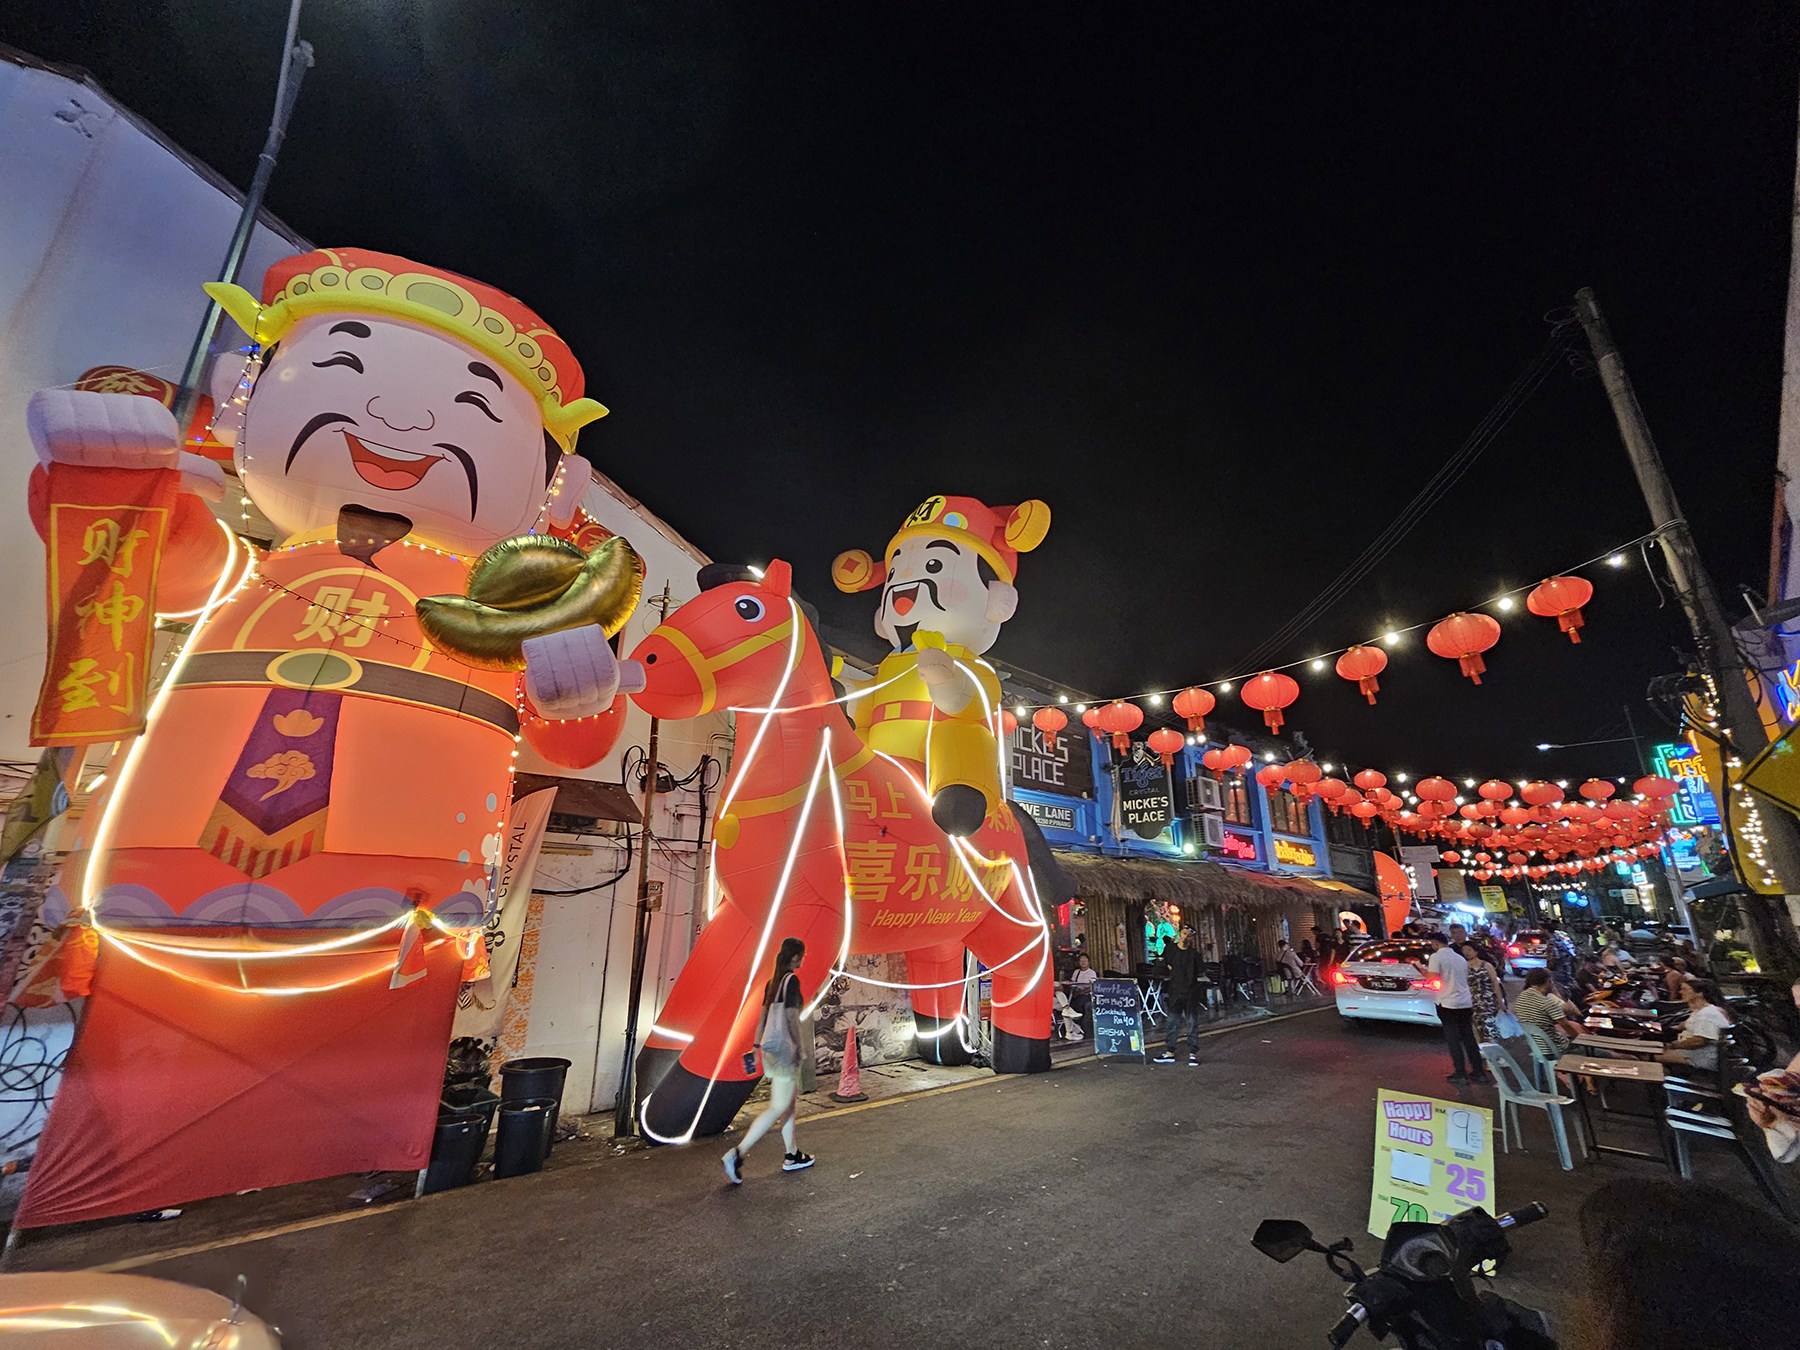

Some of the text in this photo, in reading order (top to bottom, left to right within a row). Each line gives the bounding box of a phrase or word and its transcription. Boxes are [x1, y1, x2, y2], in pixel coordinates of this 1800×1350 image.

[57, 517, 151, 716] 财神到
[293, 585, 391, 648] 财
[1012, 752, 1065, 786] PLACE
[1120, 765, 1165, 788] Tiger
[844, 779, 912, 820] 马上
[1122, 796, 1169, 811] MICKE'S
[1129, 788, 1160, 796] CRYSTAL
[1018, 802, 1071, 821] OVE LANE
[1128, 810, 1165, 824] PLACE
[498, 821, 528, 898] CRYSTAL
[840, 840, 1013, 902] 喜乐财神
[870, 907, 983, 929] Happy New Year
[1383, 1101, 1432, 1121] Happy
[1388, 1120, 1433, 1146] Hours
[1446, 1163, 1486, 1202] 25
